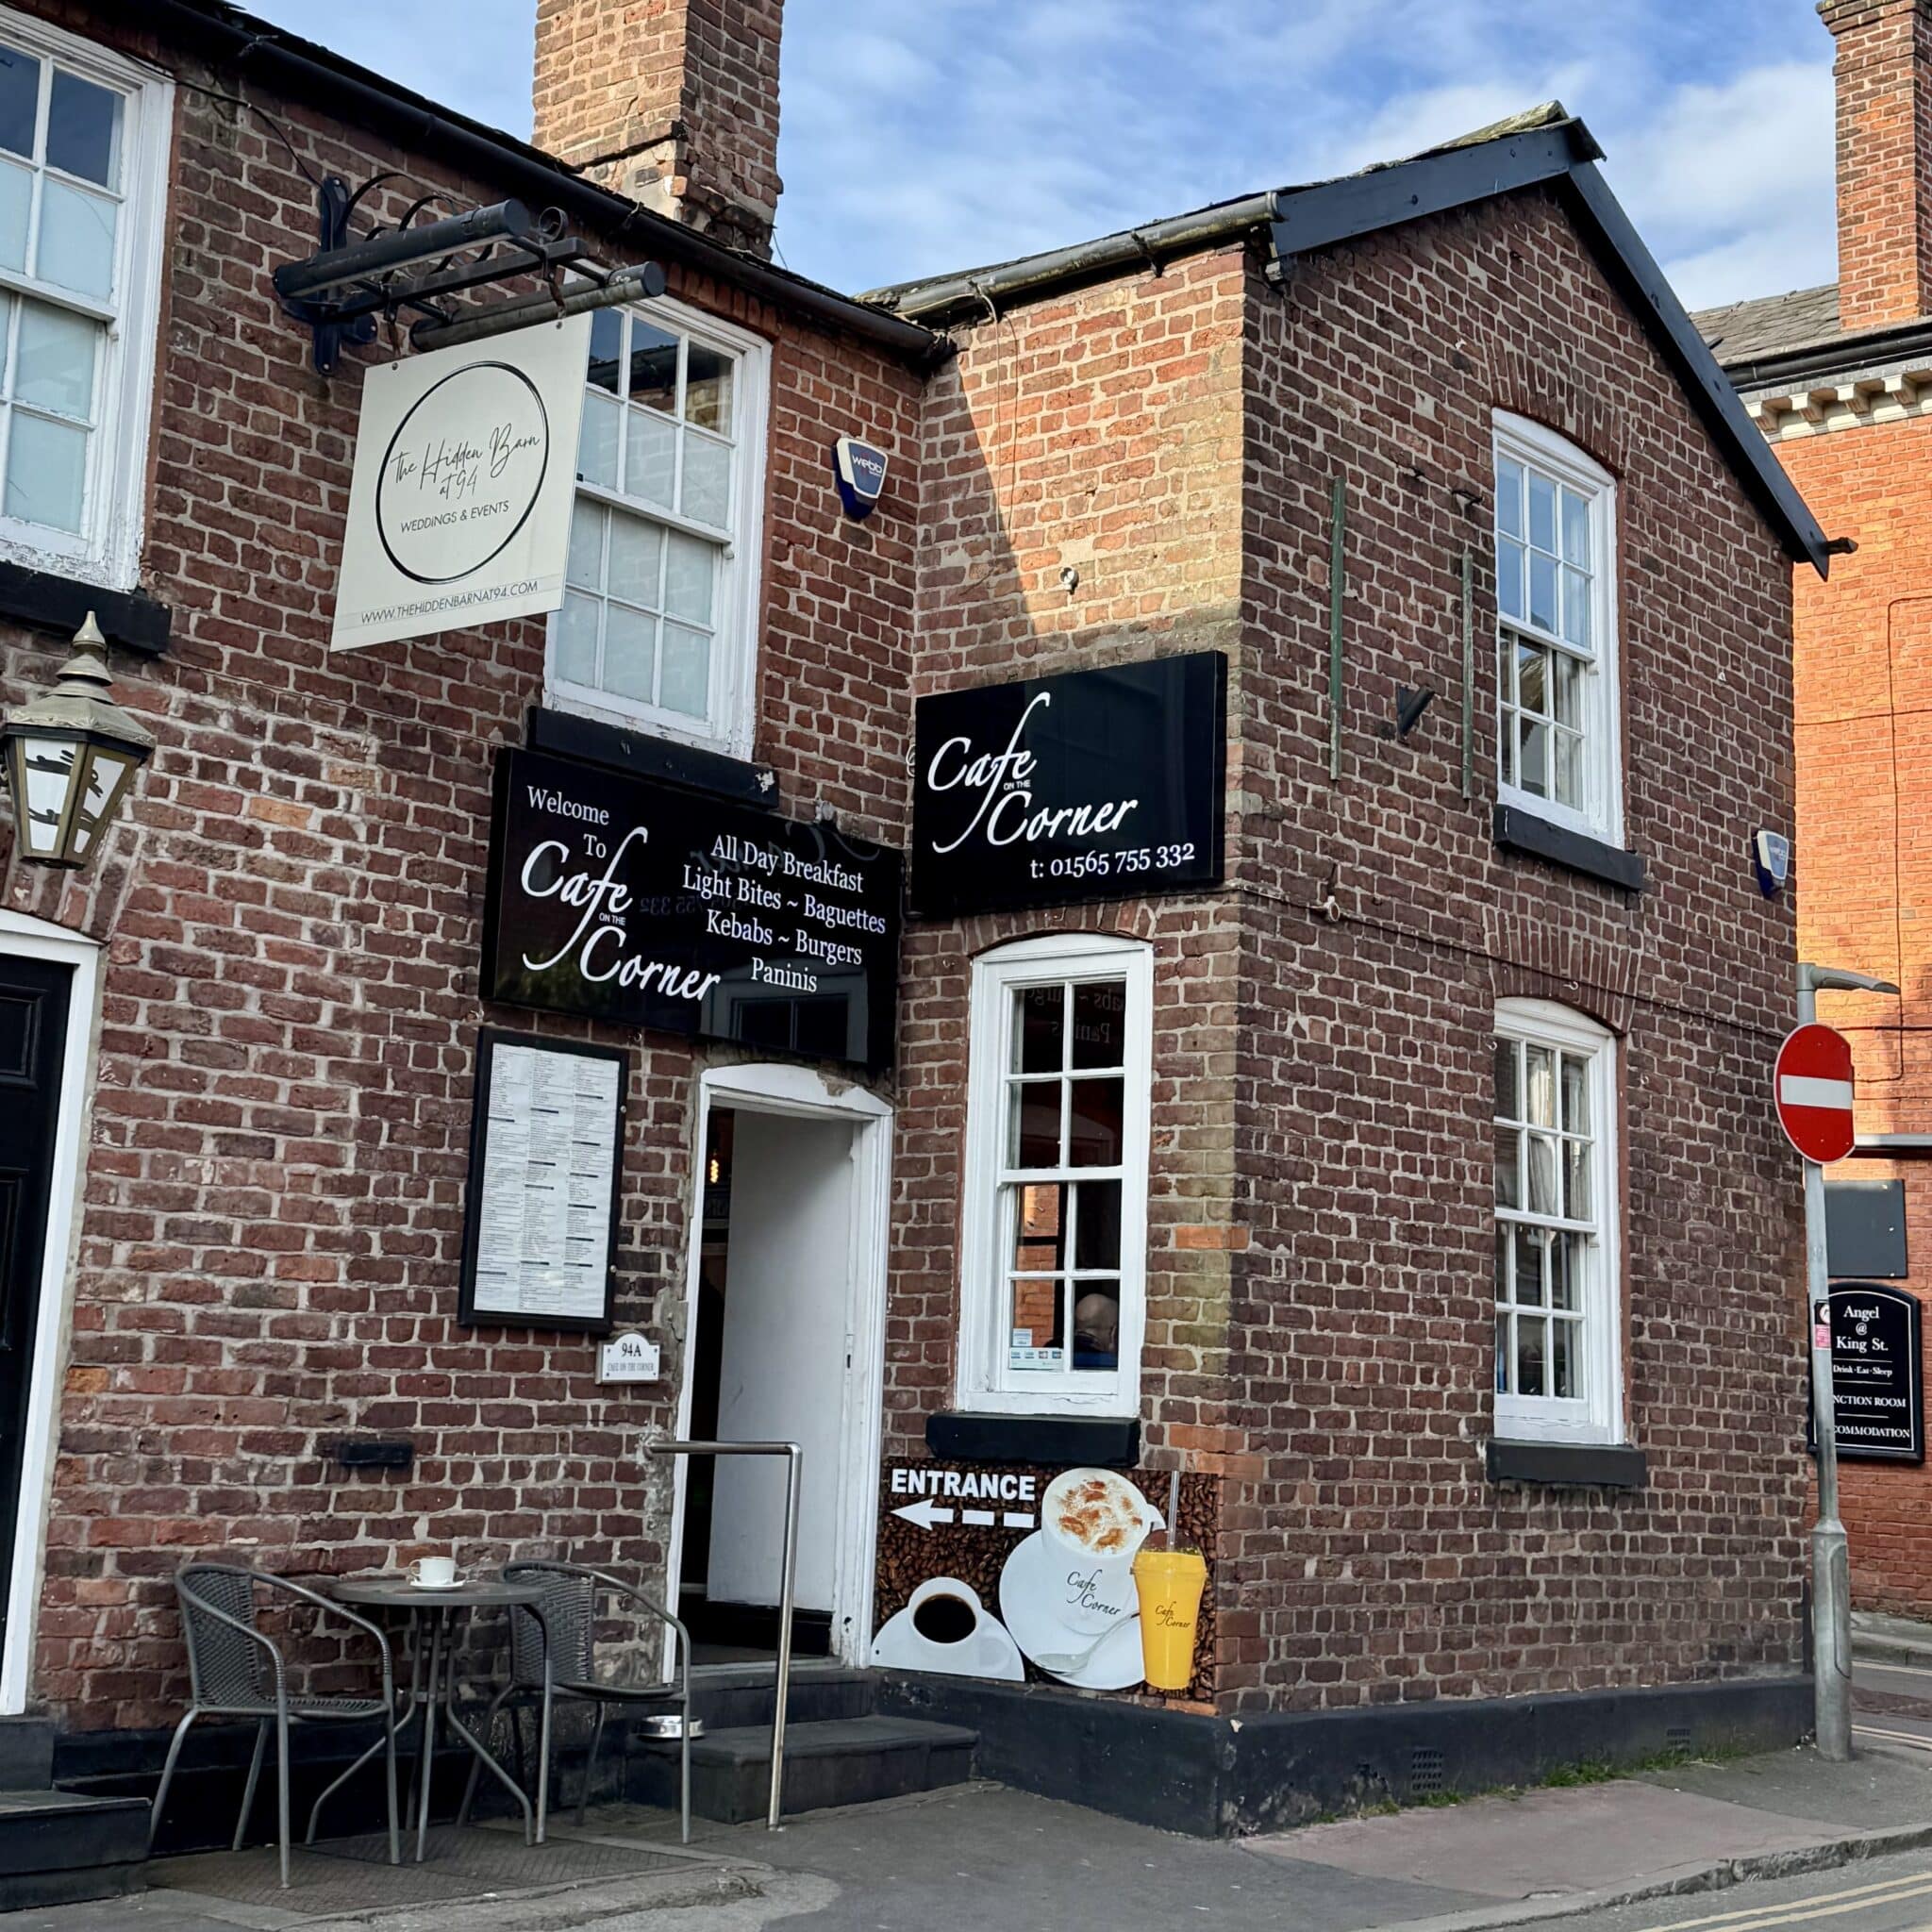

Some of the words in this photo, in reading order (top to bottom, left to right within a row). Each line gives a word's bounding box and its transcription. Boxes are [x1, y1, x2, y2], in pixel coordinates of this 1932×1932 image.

[420, 439, 483, 491] Hidden
[489, 423, 541, 478] Barn
[457, 465, 478, 500] 94
[401, 512, 458, 532] WEDDINGS
[459, 509, 468, 521] &
[471, 500, 509, 519] EVENTS
[361, 581, 538, 624] WWW.THEHIDDENBARNAT94.COM
[927, 691, 1050, 853] Cafe
[1004, 781, 1015, 791] ON
[1016, 779, 1031, 790] THE
[527, 786, 609, 825] Welcome
[987, 791, 1139, 845] Corner
[583, 833, 607, 858] To
[1030, 859, 1044, 878] t:
[1050, 851, 1110, 878] 01565
[1115, 848, 1151, 874] 755
[1156, 843, 1195, 868] 332
[710, 835, 737, 860] All
[743, 841, 777, 875] Day
[783, 851, 863, 892] Breakfast
[522, 826, 648, 970] Cafe
[682, 864, 732, 900] Light
[737, 877, 781, 909] Bites
[804, 894, 886, 934] Baguettes
[599, 913, 610, 923] ON
[611, 914, 626, 925] THE
[707, 909, 773, 945] Kebabs
[795, 930, 862, 966] Burgers
[580, 925, 721, 1000] Corner
[751, 957, 818, 992] Paninis
[1843, 1306, 1879, 1322] Angel
[1855, 1323, 1868, 1336] @
[622, 1342, 641, 1357] 94A
[1836, 1336, 1867, 1353] King
[1872, 1338, 1889, 1351] St.
[1833, 1394, 1873, 1406] NCTION
[1874, 1397, 1906, 1407] ROOM
[1834, 1425, 1910, 1439] OMMODATION
[891, 1469, 1036, 1501] ENTRANCE
[1067, 1569, 1102, 1605] Cafe
[1081, 1593, 1121, 1617] Corner
[1156, 1601, 1176, 1626] Cafe
[1165, 1616, 1191, 1629] Corner
